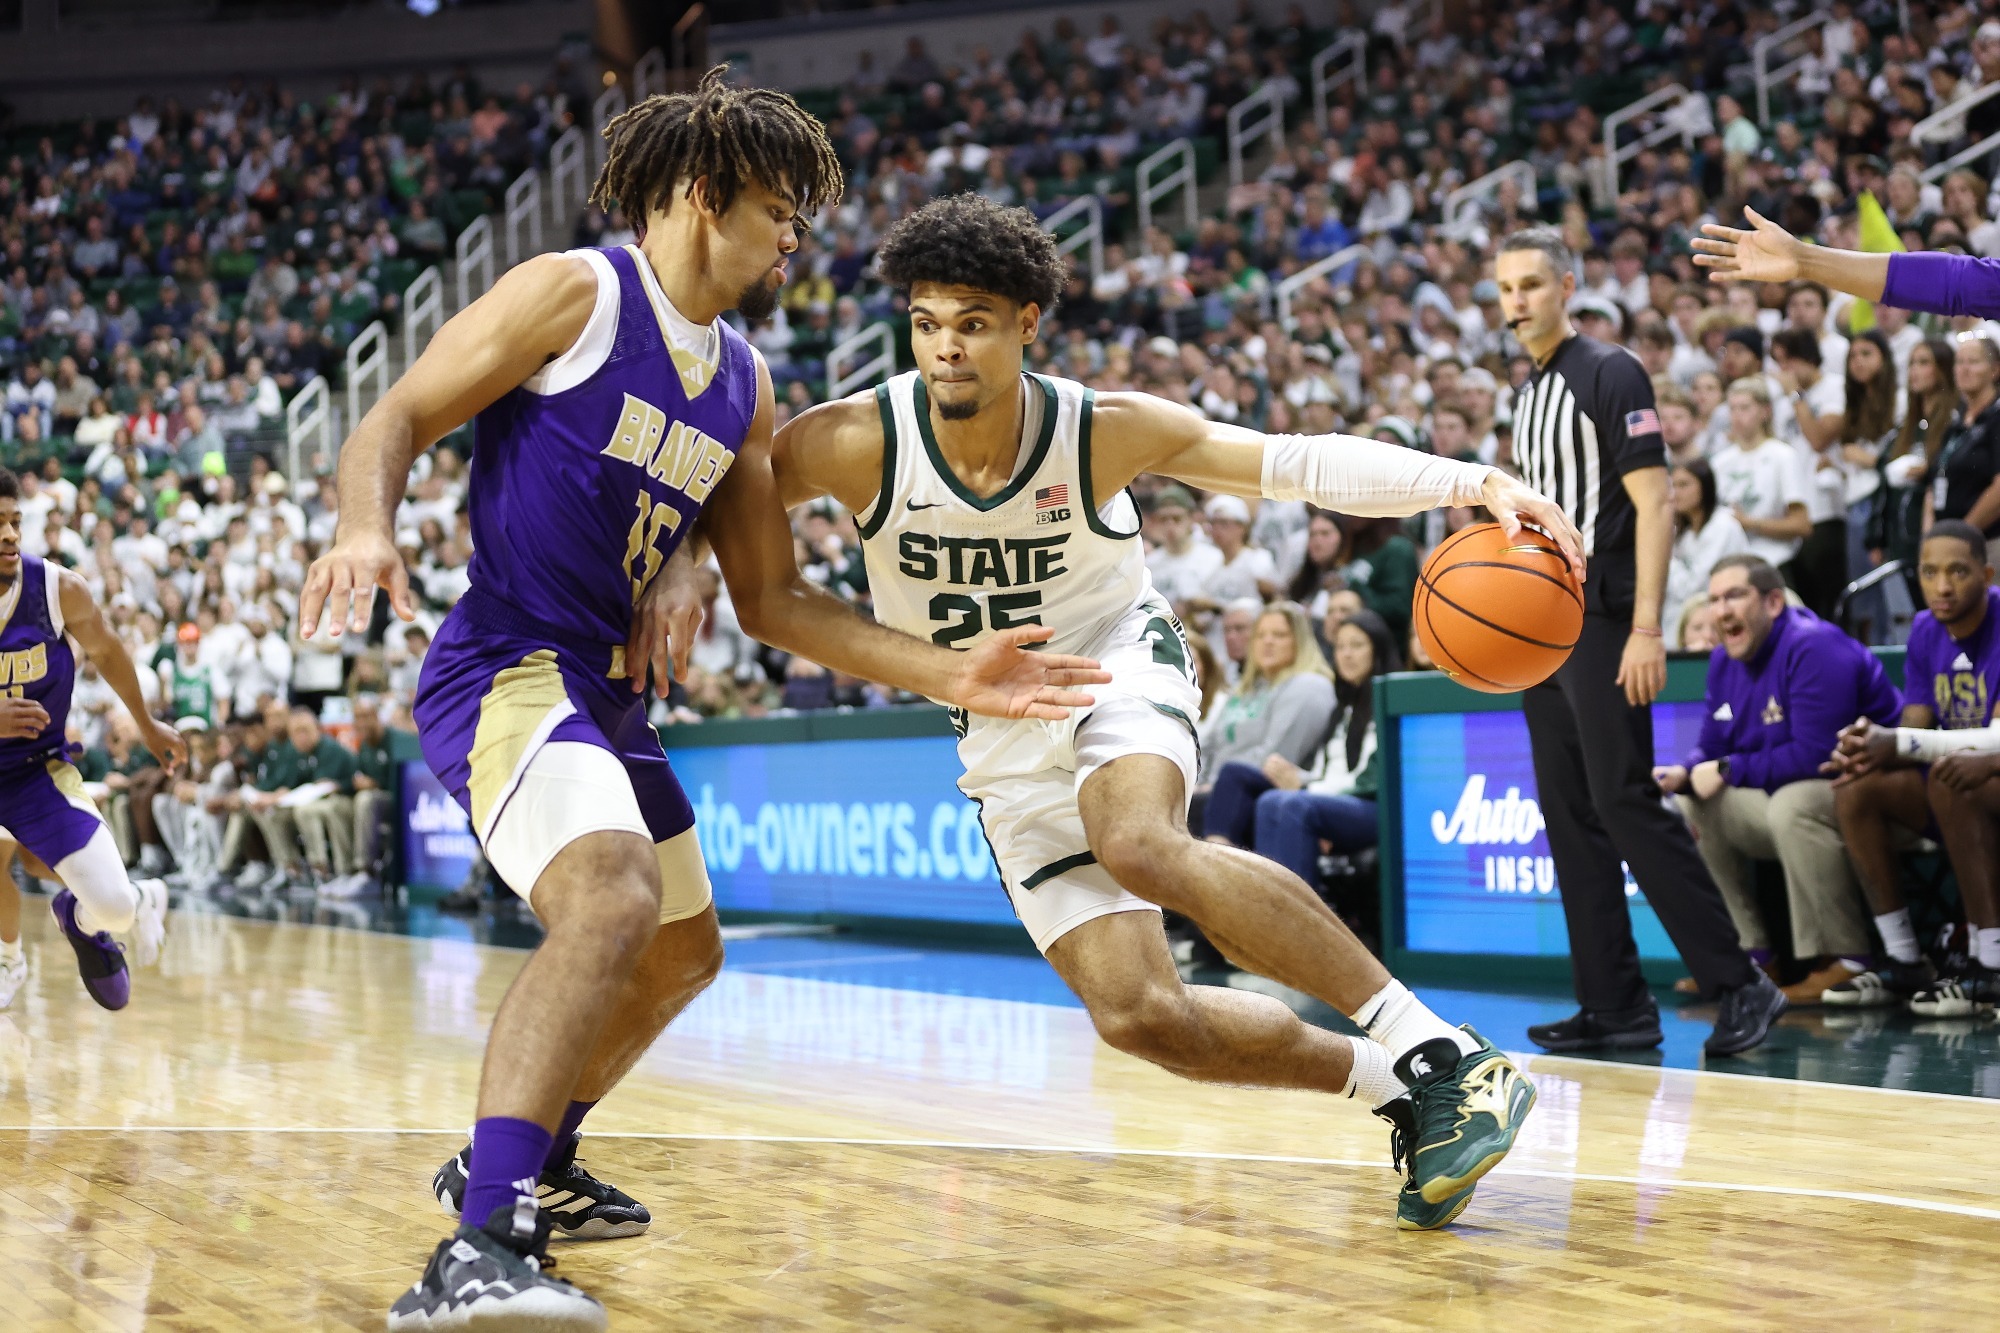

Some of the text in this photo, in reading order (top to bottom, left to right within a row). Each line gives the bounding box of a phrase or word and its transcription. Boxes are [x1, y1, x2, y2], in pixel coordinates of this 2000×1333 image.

[600, 391, 736, 506] BRAVES
[899, 531, 1072, 588] STATE
[929, 590, 1048, 651] 25
[692, 782, 1001, 882] to-owners.co
[1484, 855, 1555, 894] INSU
